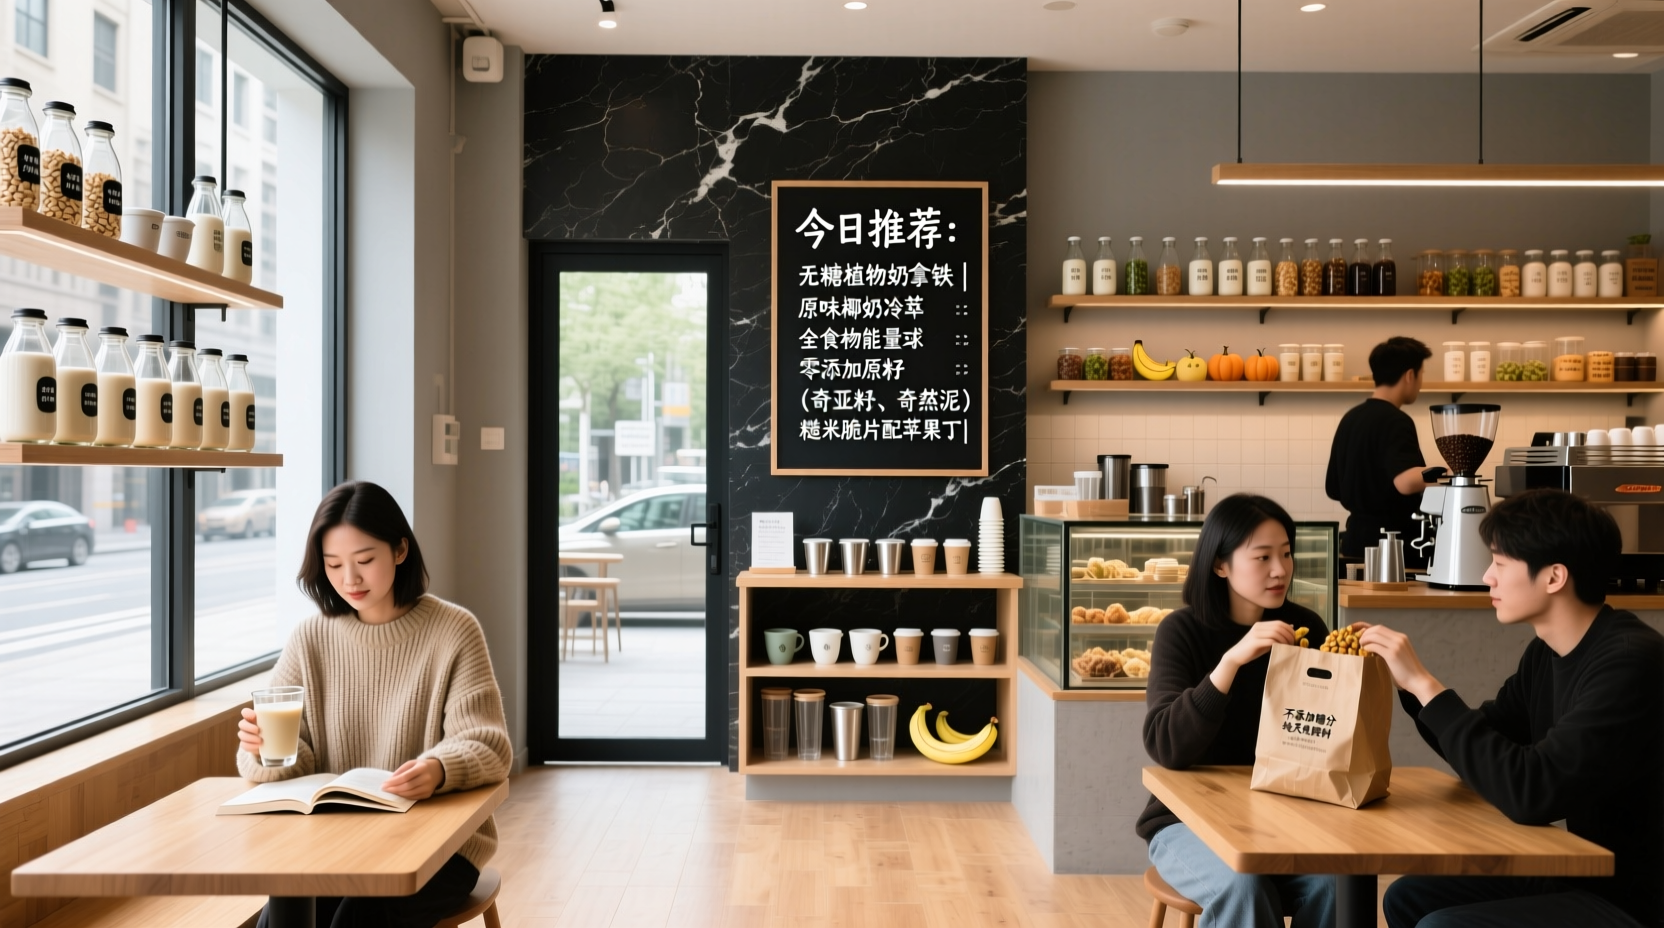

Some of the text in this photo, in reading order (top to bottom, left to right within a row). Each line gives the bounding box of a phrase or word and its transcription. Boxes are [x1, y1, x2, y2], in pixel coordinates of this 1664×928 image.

[795, 206, 956, 250] 今日推荐：
[799, 262, 954, 289] 无糖植物奶拿铁
